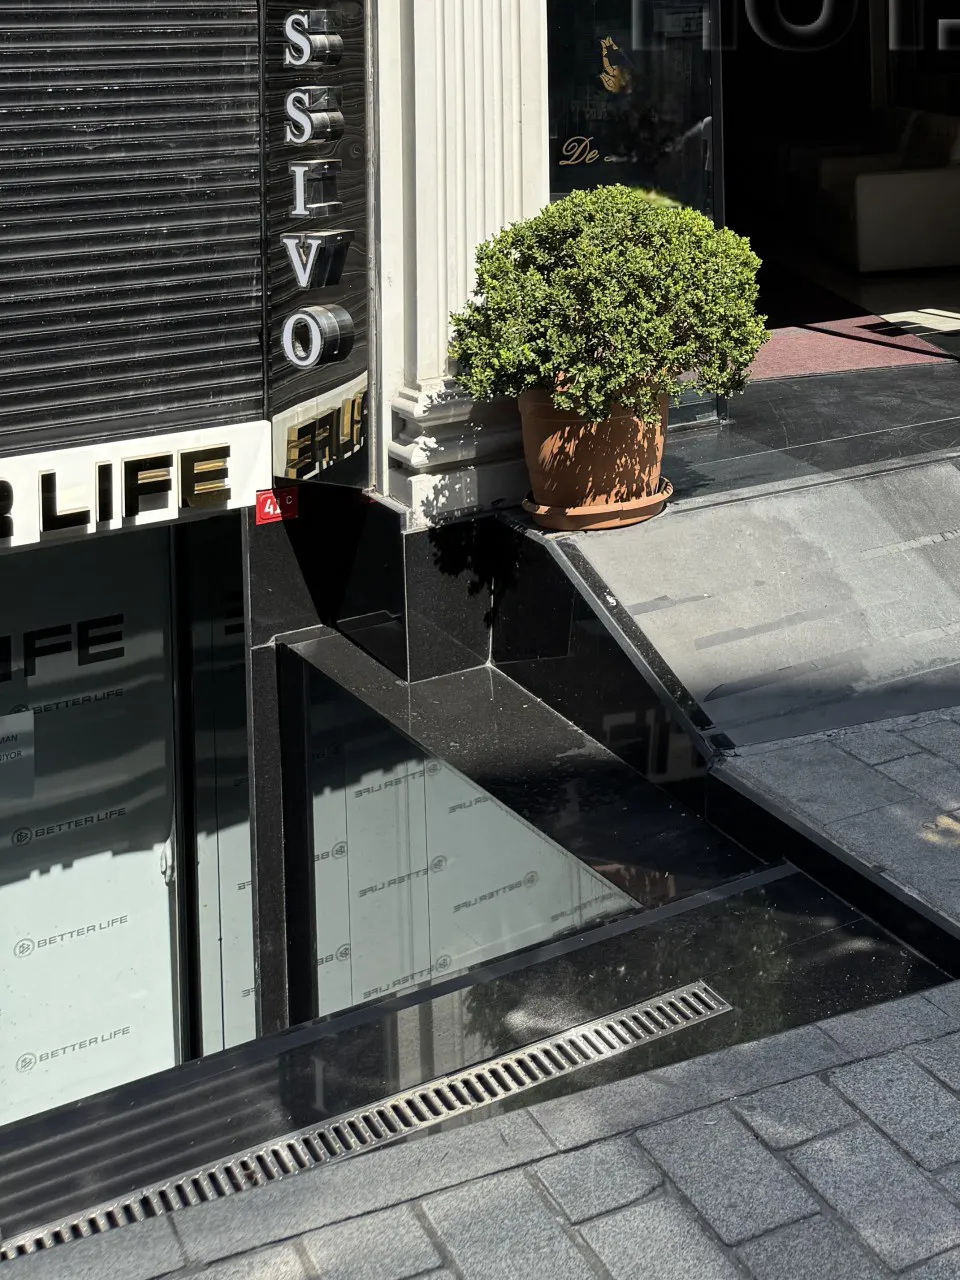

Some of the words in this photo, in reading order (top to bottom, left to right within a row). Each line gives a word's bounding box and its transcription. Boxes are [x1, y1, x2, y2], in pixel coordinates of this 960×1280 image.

[558, 135, 600, 166] De
[38, 444, 231, 533] LIFE
[32, 695, 92, 716] BETTER
[94, 687, 125, 702] LIFE
[34, 815, 95, 838] BETTER
[97, 807, 127, 822] LIFE
[37, 923, 97, 949] BETTER
[99, 914, 129, 930] LIFE
[39, 1036, 99, 1062] BETTER
[101, 1025, 131, 1042] LIFE
